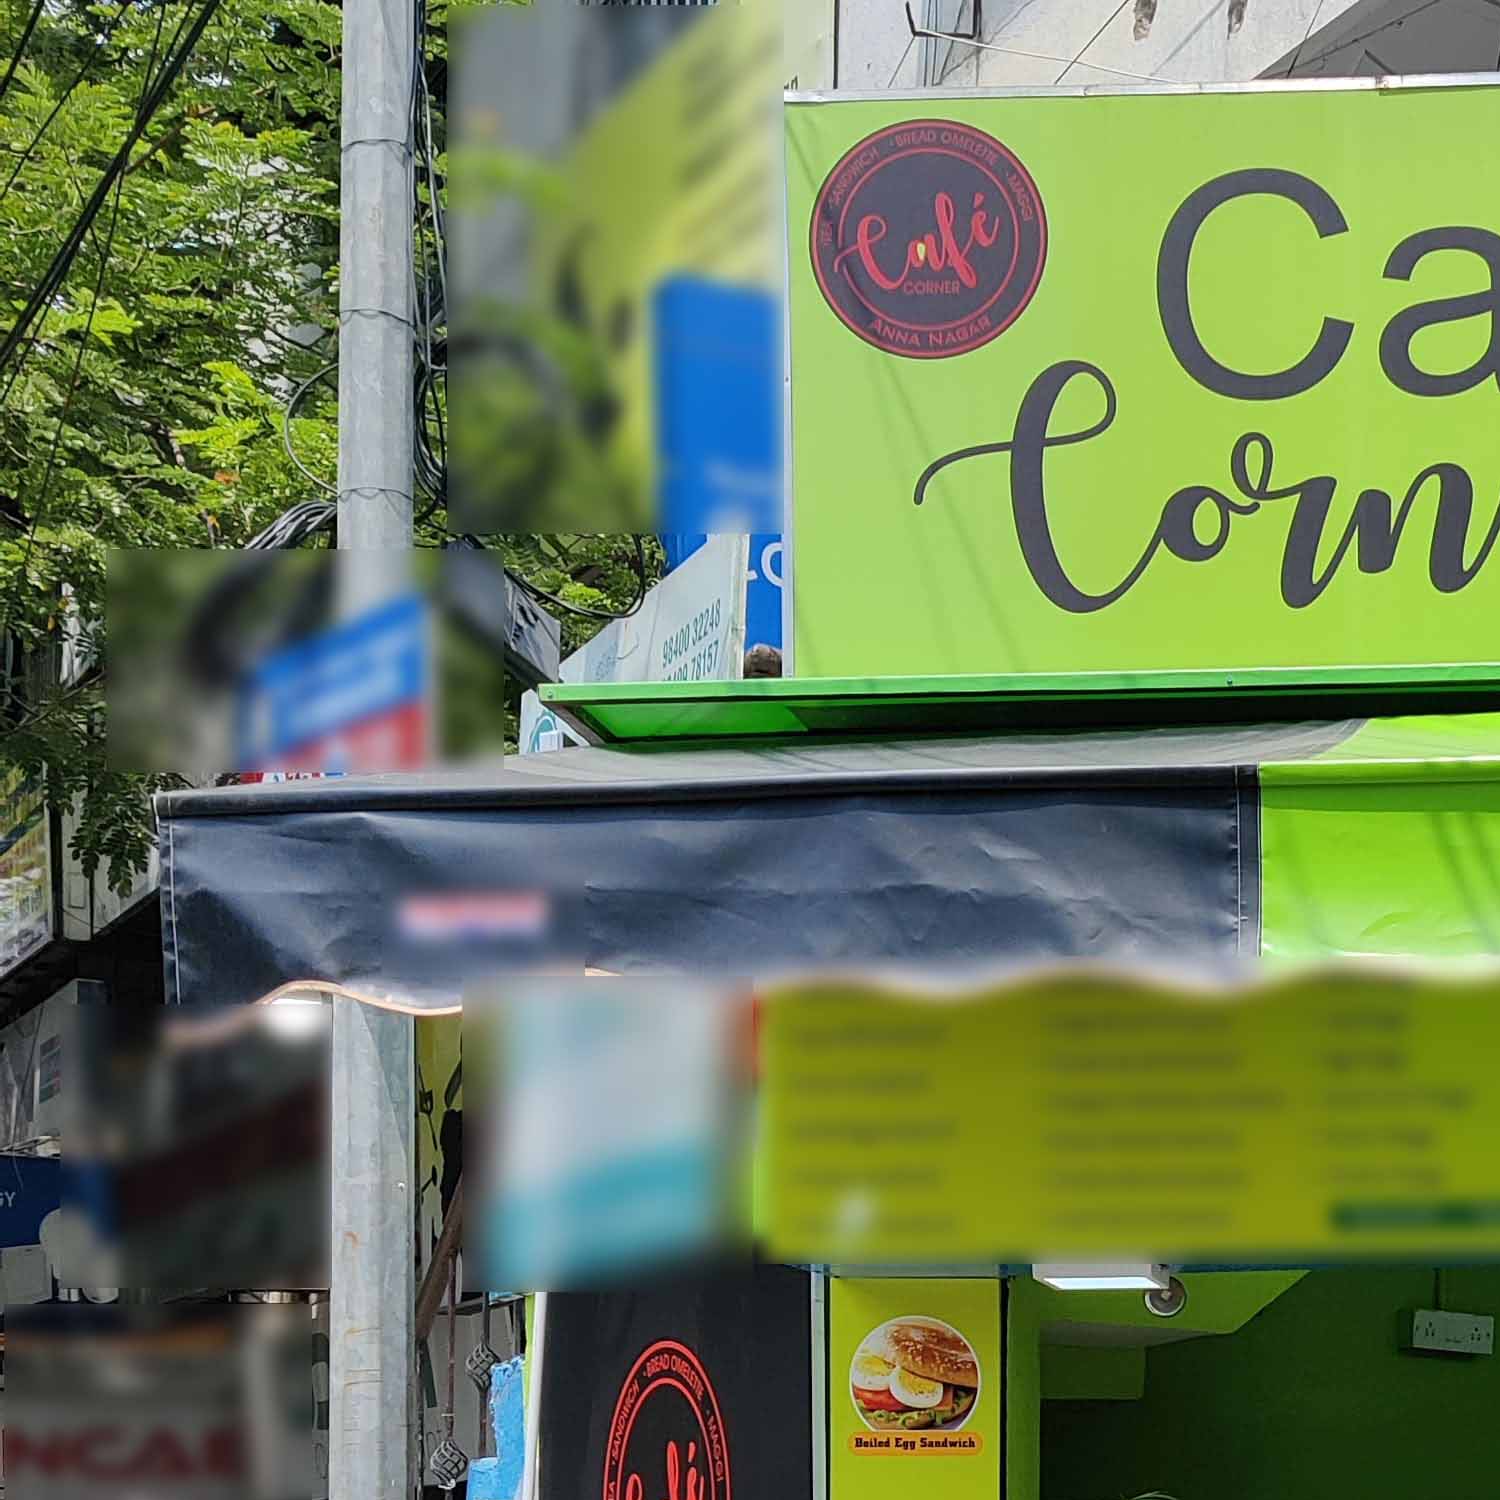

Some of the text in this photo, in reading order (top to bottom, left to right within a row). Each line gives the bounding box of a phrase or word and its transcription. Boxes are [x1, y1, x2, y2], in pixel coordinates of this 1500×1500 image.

[903, 279, 961, 296] CORNER
[854, 1437, 976, 1452] Boiled Egg Sandwich
